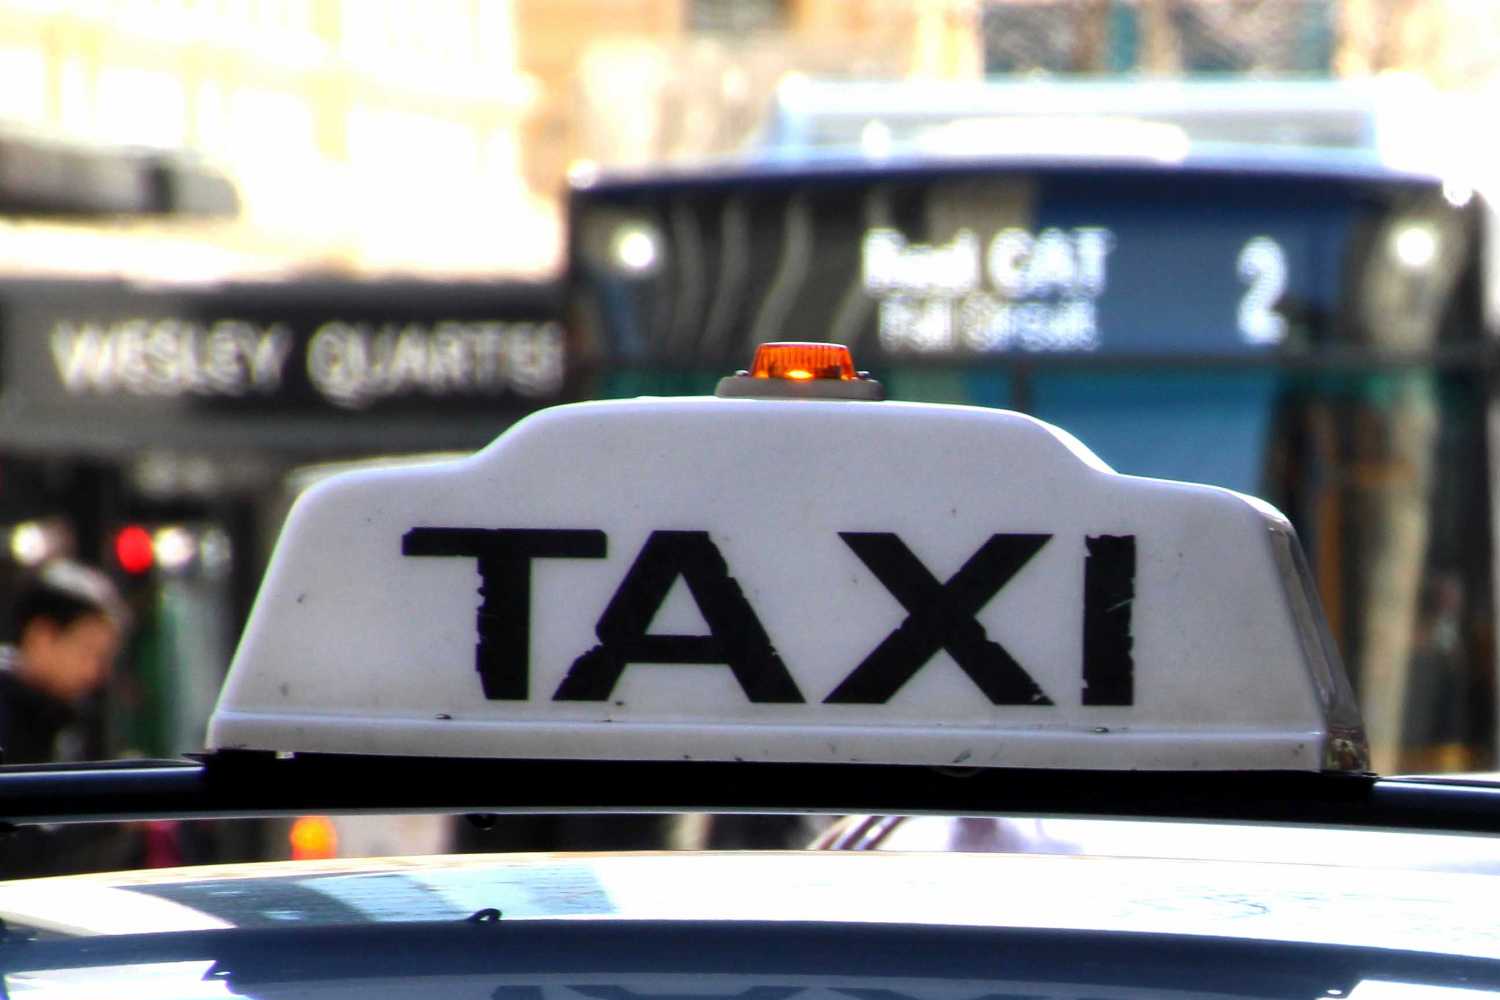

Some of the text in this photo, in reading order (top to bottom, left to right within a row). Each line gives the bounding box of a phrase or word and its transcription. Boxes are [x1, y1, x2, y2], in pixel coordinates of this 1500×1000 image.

[1236, 237, 1290, 345] 2
[52, 322, 290, 393] WESLEY
[401, 526, 1138, 708] TAXI
